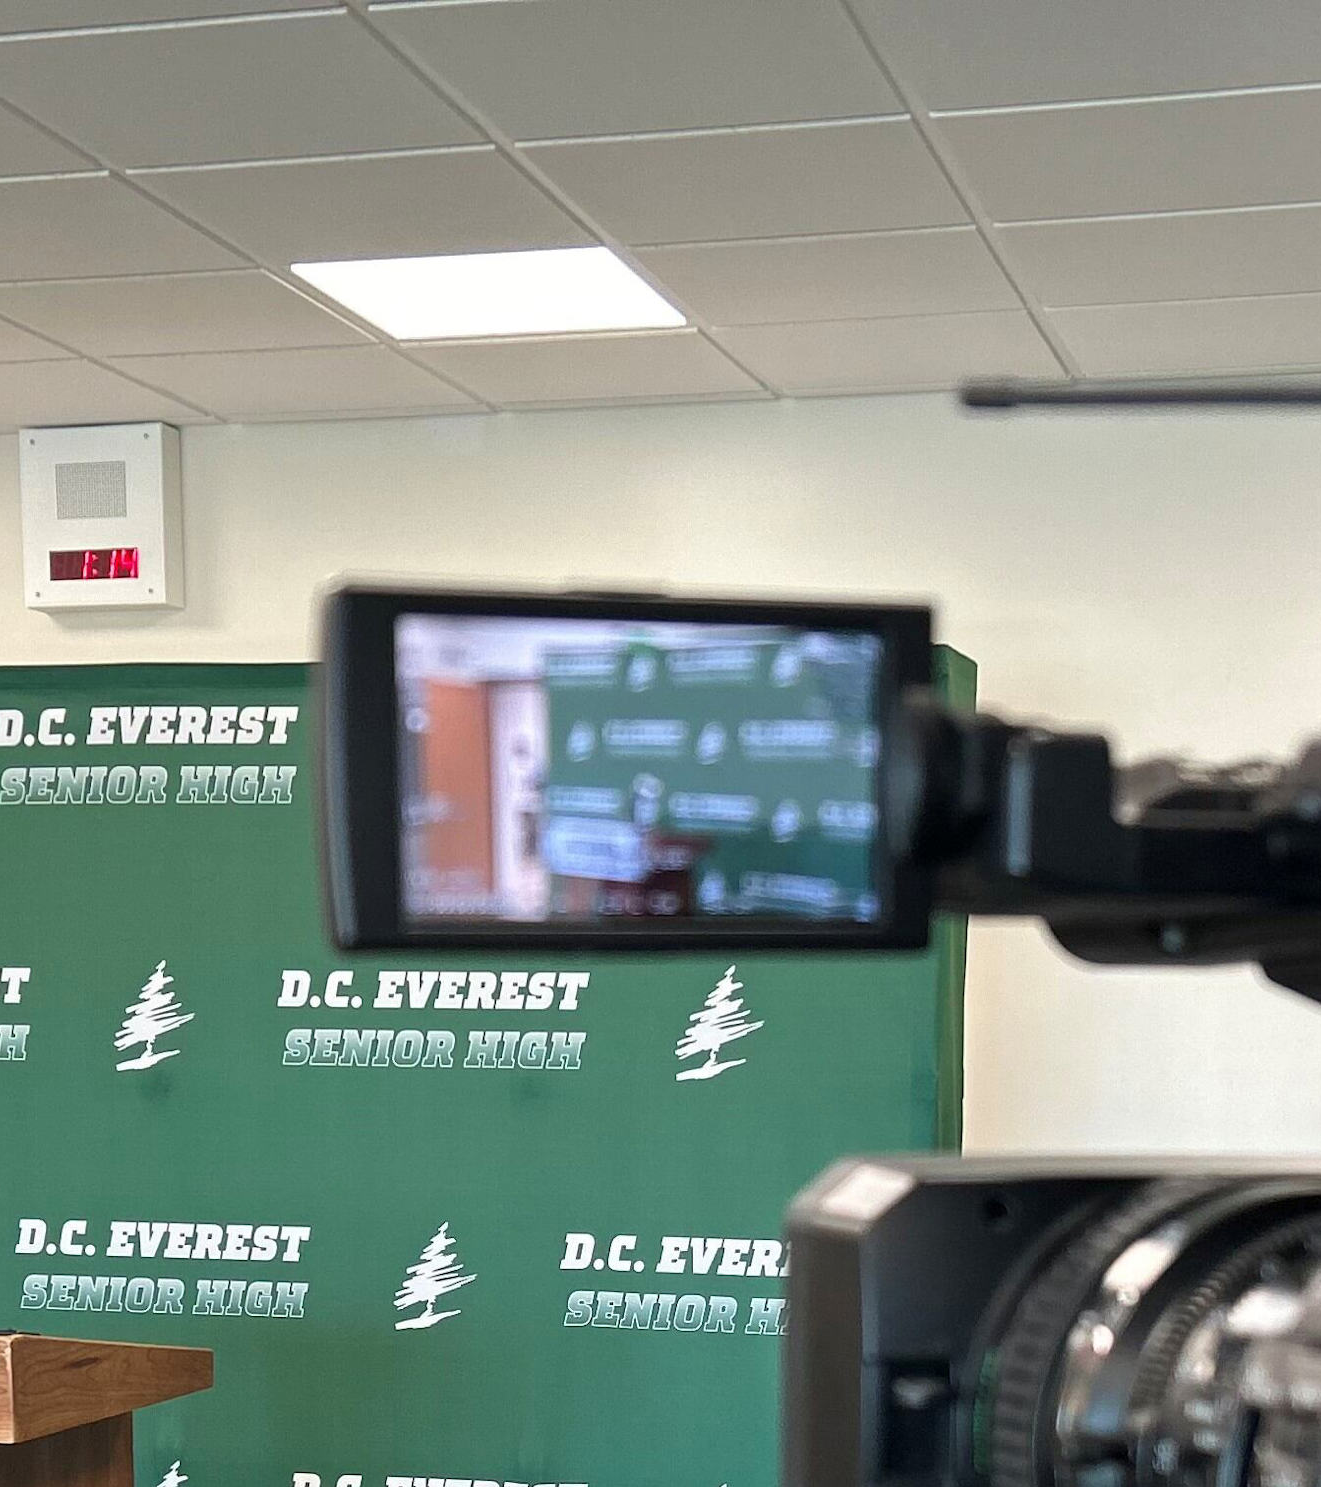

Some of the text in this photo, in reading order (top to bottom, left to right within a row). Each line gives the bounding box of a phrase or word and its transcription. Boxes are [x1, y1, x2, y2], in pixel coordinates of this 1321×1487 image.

[86, 706, 299, 745] EVEREST
[0, 766, 297, 804] SENIOR HIGH
[277, 970, 590, 1010] D.C. EVEREST
[283, 1029, 586, 1069] SENIOR HIGH
[15, 1219, 311, 1262] D.C. EVEREST
[560, 1233, 790, 1277] D.C. EVER
[21, 1274, 309, 1318] SENIOR HIGH
[564, 1291, 737, 1333] SENIOR
